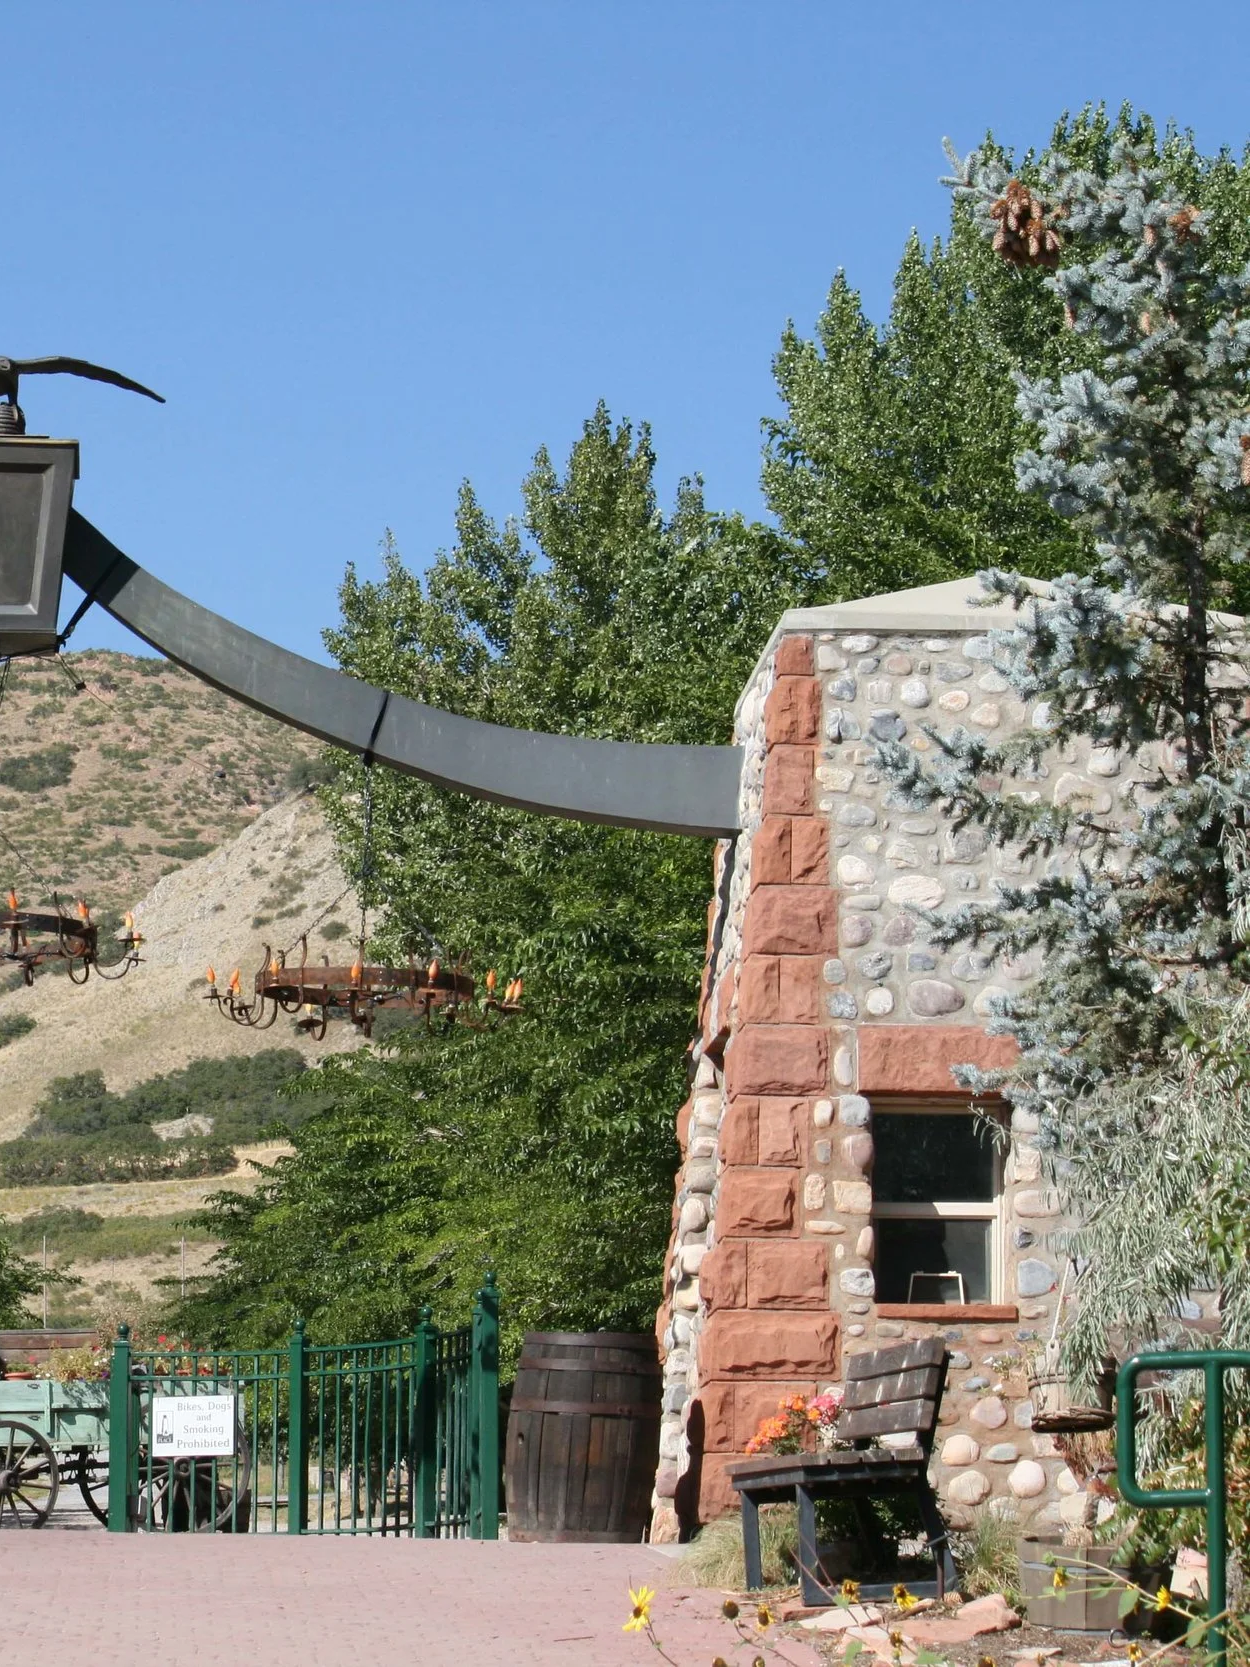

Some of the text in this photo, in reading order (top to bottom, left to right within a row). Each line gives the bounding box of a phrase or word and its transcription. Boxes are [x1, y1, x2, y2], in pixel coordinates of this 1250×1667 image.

[177, 1402, 231, 1412] Bikes, Dogs
[183, 1425, 224, 1435] Smoking
[177, 1438, 230, 1448] Prohibited
